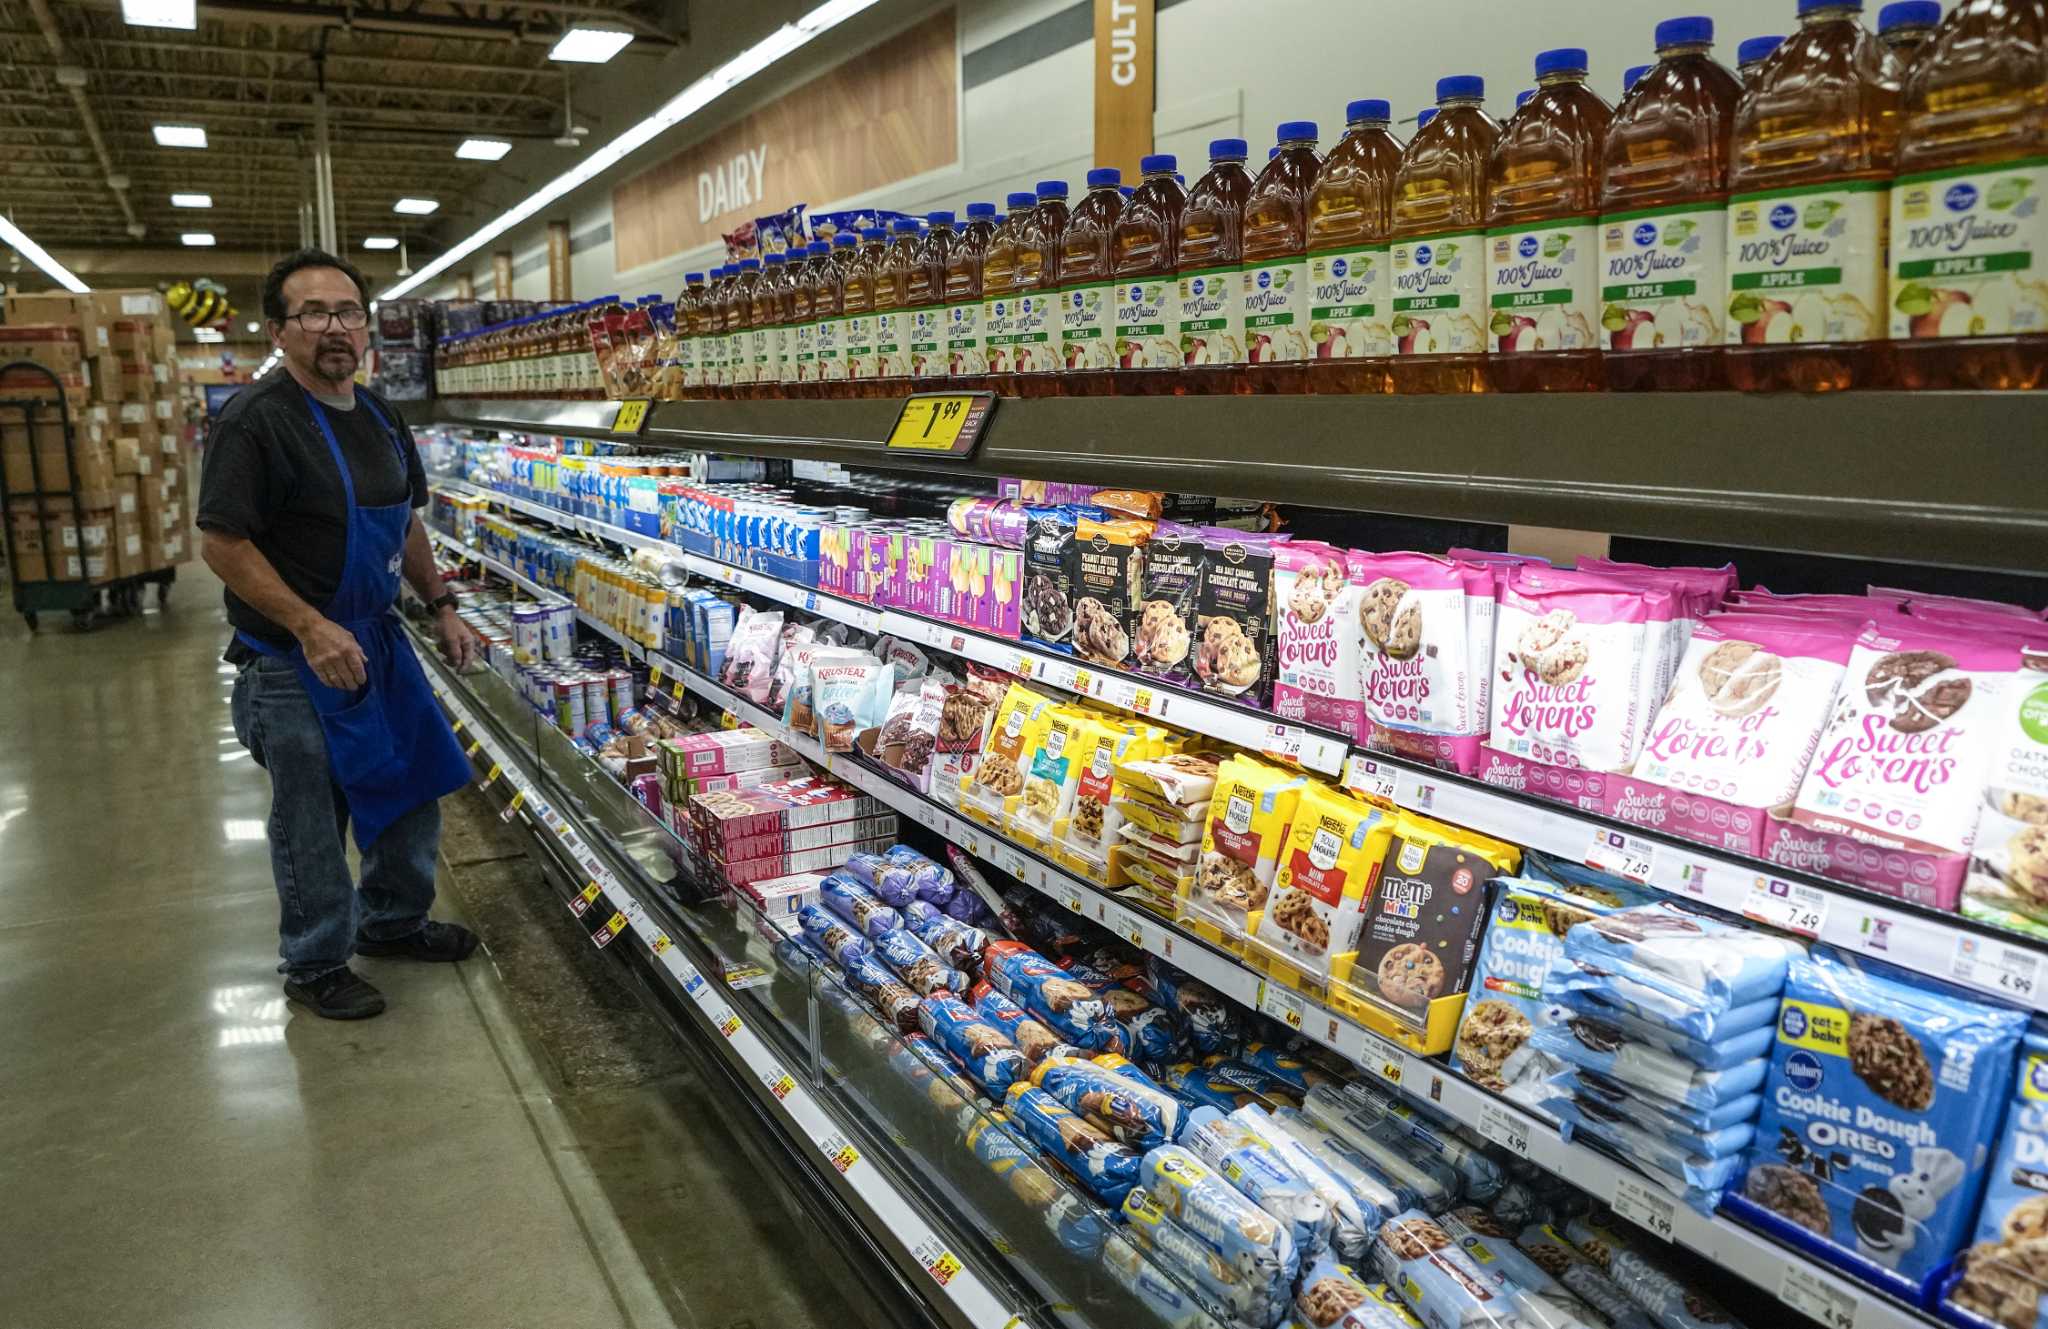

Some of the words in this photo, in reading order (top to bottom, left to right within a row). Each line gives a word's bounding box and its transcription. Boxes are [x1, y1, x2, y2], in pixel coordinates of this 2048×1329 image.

[699, 144, 767, 223] DAIRY
[1947, 215, 2018, 252] Juice
[1772, 233, 1830, 266] Juice
[1521, 260, 1563, 288] Juice
[1636, 249, 1686, 279] Juice
[1933, 256, 1986, 277] APPLE
[1417, 267, 1452, 293] Juice
[1761, 272, 1805, 287] APPLE
[1260, 290, 1287, 312] Juice
[1335, 279, 1368, 302] Juice
[1513, 292, 1545, 305] APPLE
[1627, 284, 1664, 298] APPLE
[1329, 308, 1353, 318] APPLE
[1410, 297, 1438, 309] APPLE
[1256, 316, 1276, 326] APPLE
[1286, 611, 1335, 641] Sweet
[1277, 632, 1338, 670] Loren's
[818, 667, 867, 680] KRUSTEAZ
[1377, 650, 1425, 680] Sweet
[1366, 669, 1431, 706] Loren's
[1523, 668, 1596, 704] Sweet
[1281, 691, 1304, 710] Sweet
[1501, 691, 1597, 738] Loren's
[1857, 713, 1966, 754] Sweet
[1284, 741, 1301, 754] 7.49
[1491, 756, 1525, 777] Sweet
[1375, 780, 1394, 796] 7.49
[1624, 786, 1665, 809] Sweet
[1228, 810, 1249, 825] HOUSE
[1313, 843, 1337, 858] HOUSE
[1321, 834, 1336, 848] TOLL
[1779, 828, 1827, 852] Sweet
[1308, 867, 1325, 881] MINI
[1622, 857, 1649, 875] 7.49
[1375, 914, 1405, 928] chocolate
[1405, 919, 1421, 931] chip
[1788, 907, 1820, 930] 7.49
[1373, 923, 1395, 934] cookie
[1395, 926, 1415, 939] dough
[1491, 927, 1565, 960] Cookie
[1488, 951, 1545, 988] Doug
[1503, 984, 1540, 998] Monster
[2000, 973, 2033, 994] 4.99
[1811, 1016, 1832, 1028] eat
[1810, 1028, 1842, 1045] bake
[1785, 1060, 1824, 1079] Pillsbury
[1775, 1086, 1852, 1124] Cookie
[1856, 1104, 1937, 1147] Dough
[1506, 1134, 1527, 1152] 4.99
[1807, 1121, 1896, 1160] OREO
[1851, 1153, 1895, 1176] Pieces
[1183, 1207, 1225, 1243] Dough
[1647, 1214, 1673, 1235] 4.99
[935, 1258, 956, 1280] 3.24
